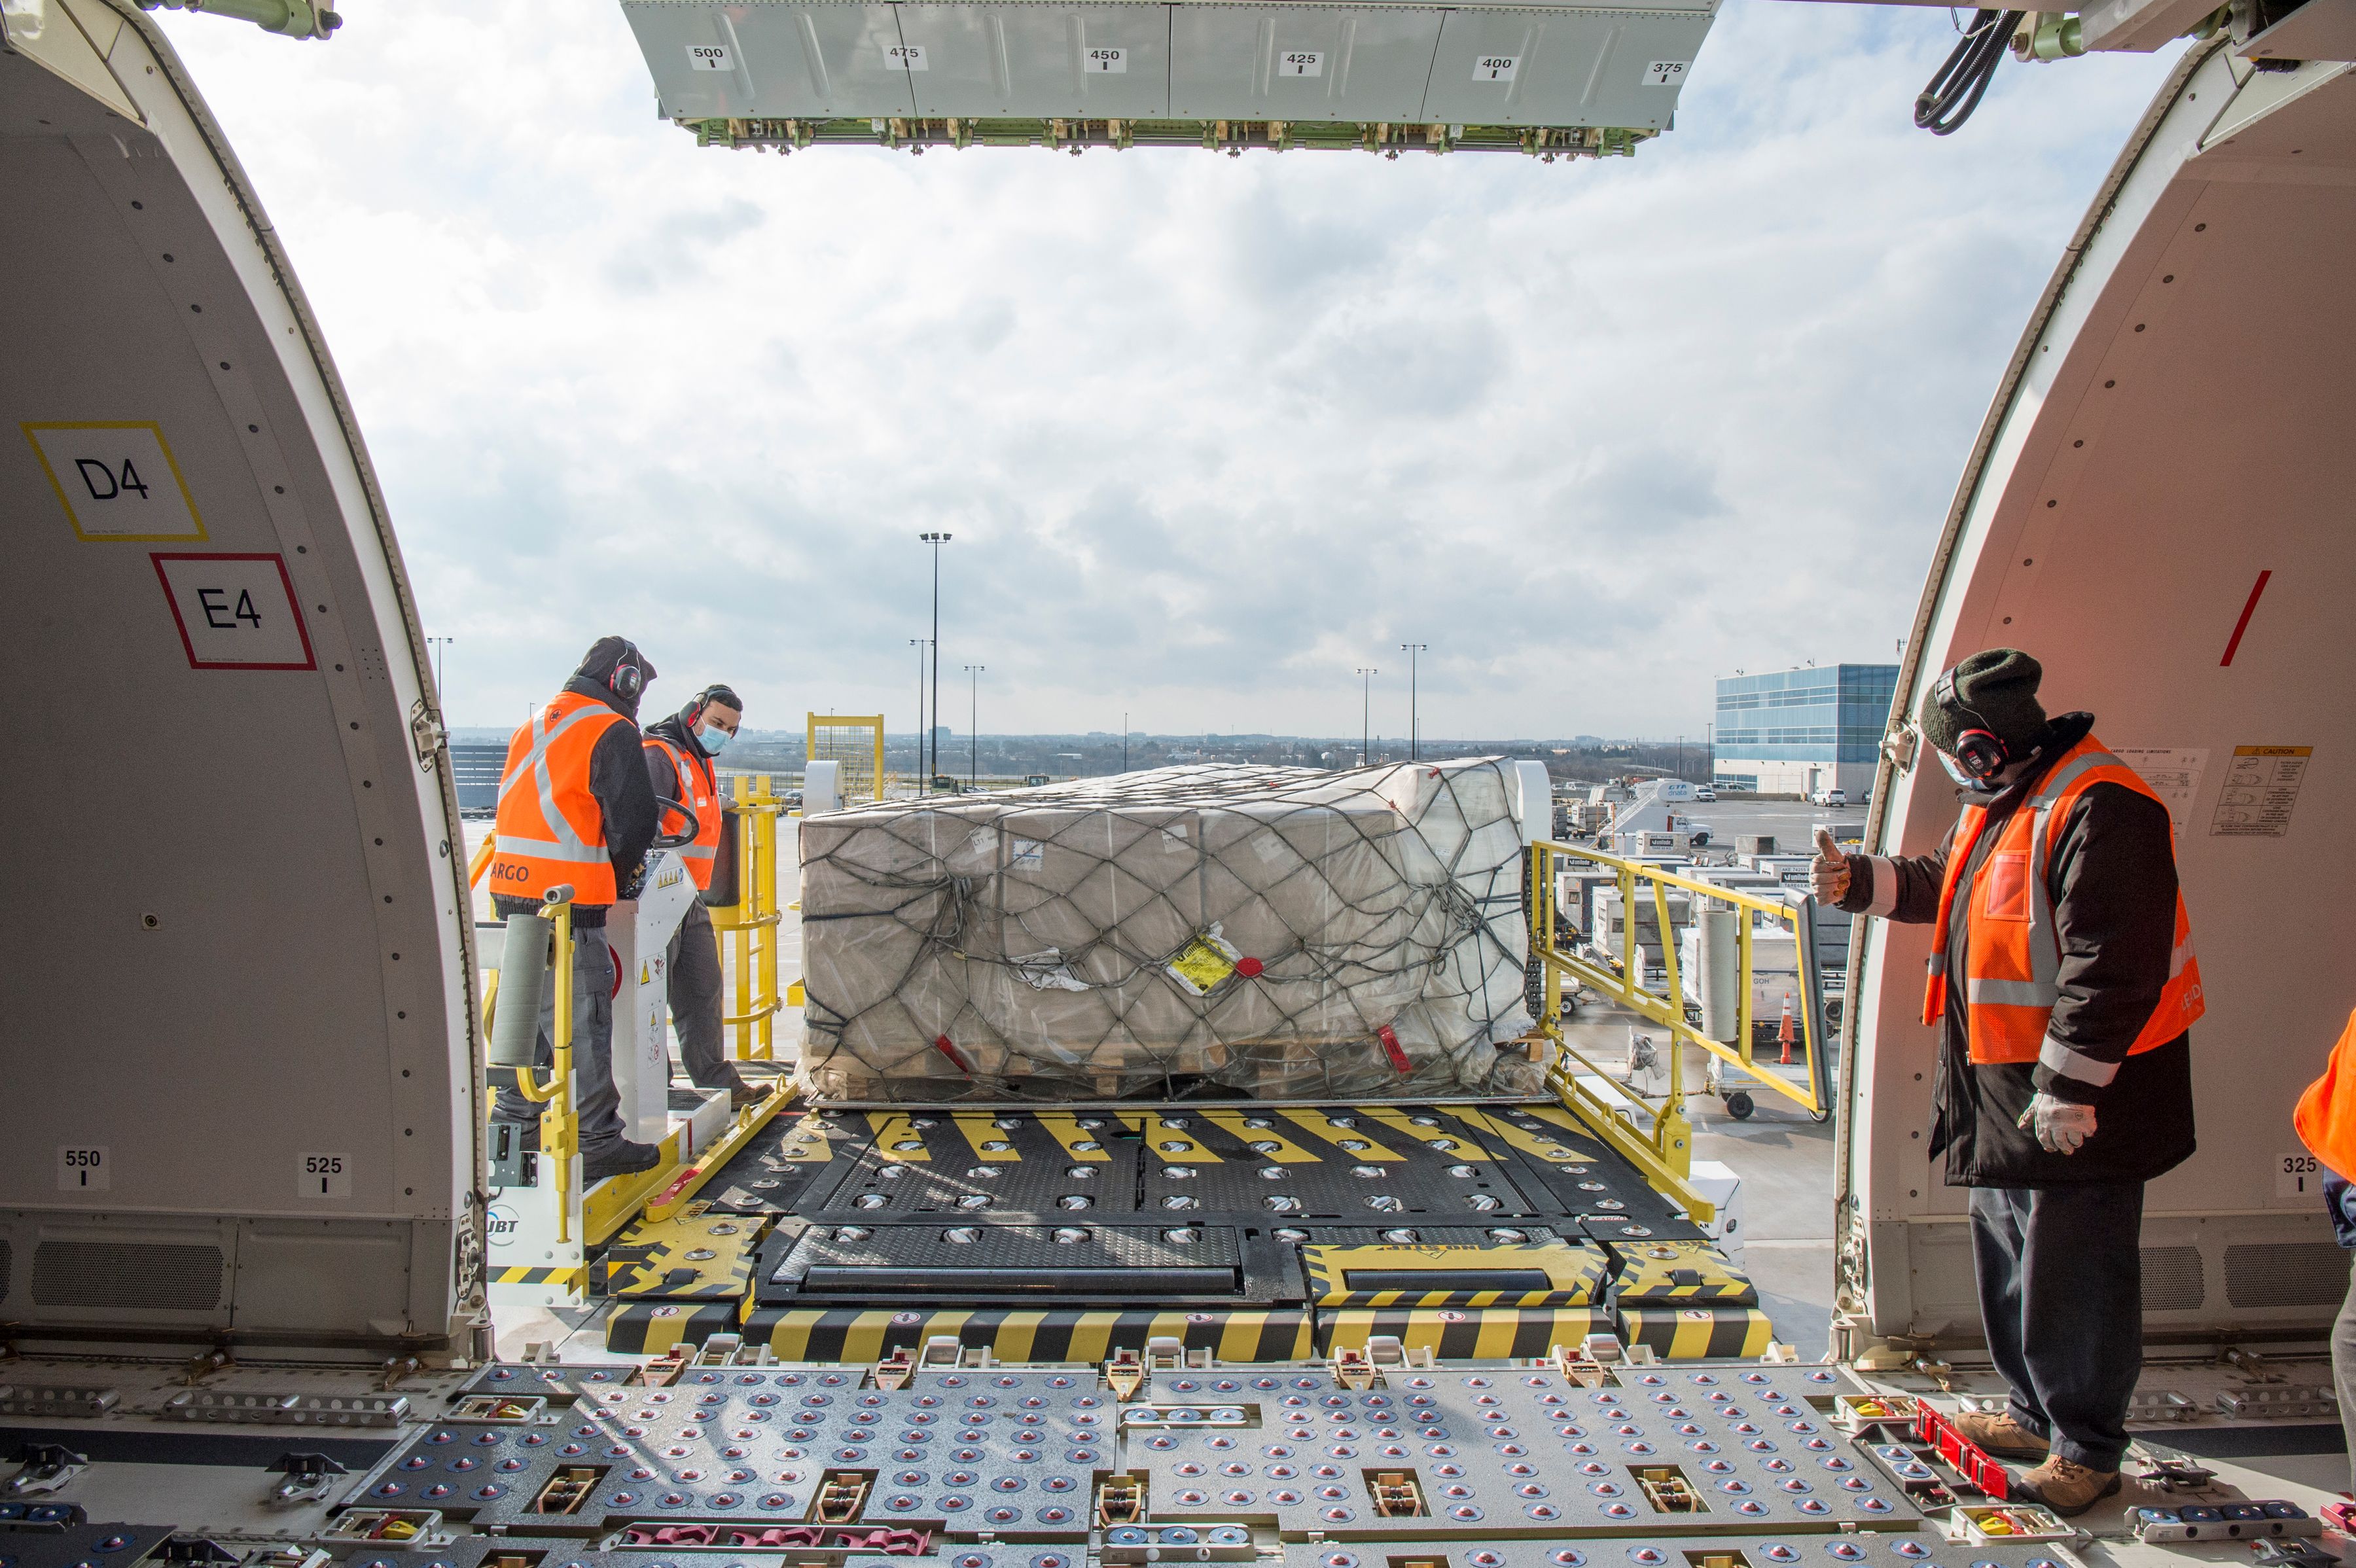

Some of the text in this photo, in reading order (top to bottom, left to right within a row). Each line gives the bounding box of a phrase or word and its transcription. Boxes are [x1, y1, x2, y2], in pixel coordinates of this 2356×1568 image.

[694, 48, 723, 58] 500
[889, 47, 919, 58] 475
[1090, 50, 1120, 60] 450
[1287, 54, 1316, 63] 425
[1482, 58, 1512, 68] 400
[1653, 63, 1683, 73] 375
[75, 458, 149, 499] D4
[197, 589, 262, 628] E4
[65, 1150, 101, 1167] 550
[306, 1157, 342, 1173] 525
[2283, 1157, 2317, 1173] 325
[488, 1221, 518, 1233] JBT
